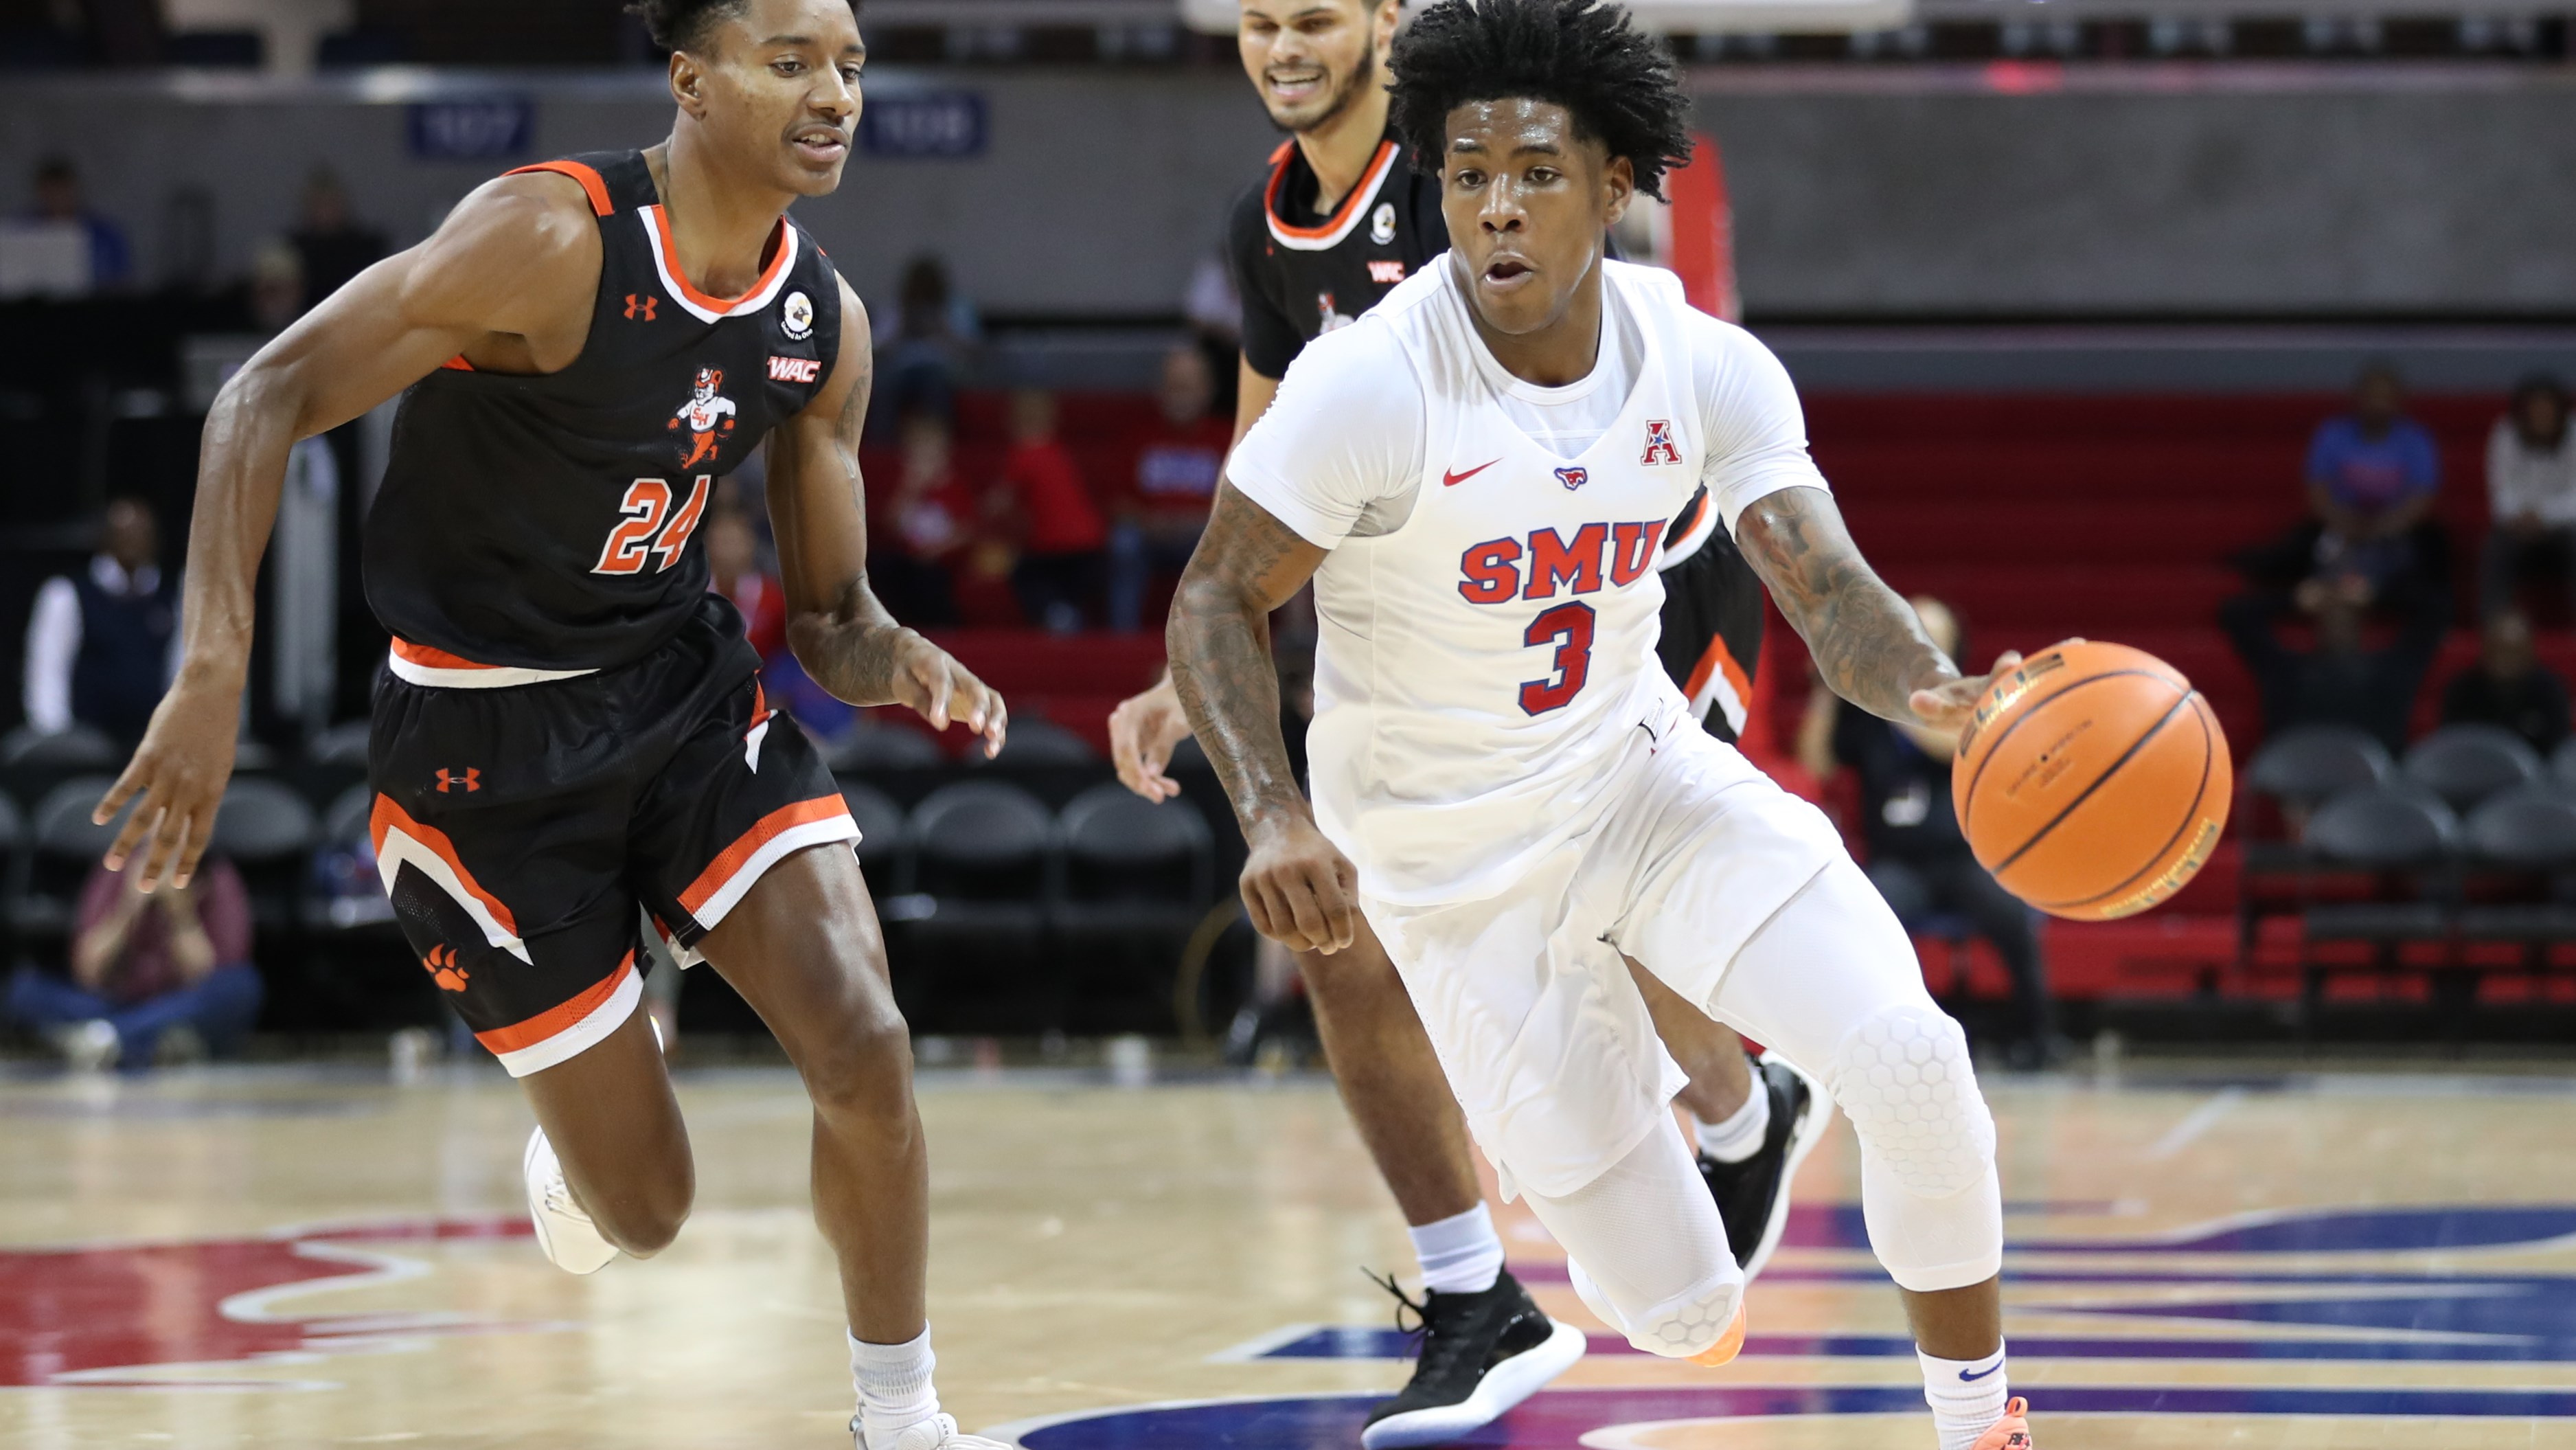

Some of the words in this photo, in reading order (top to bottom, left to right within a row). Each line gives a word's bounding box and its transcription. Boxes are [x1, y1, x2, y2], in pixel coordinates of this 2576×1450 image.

[767, 356, 821, 383] WAC
[589, 474, 711, 575] 24
[1458, 518, 1668, 604] SMU
[1518, 600, 1596, 716] 3
